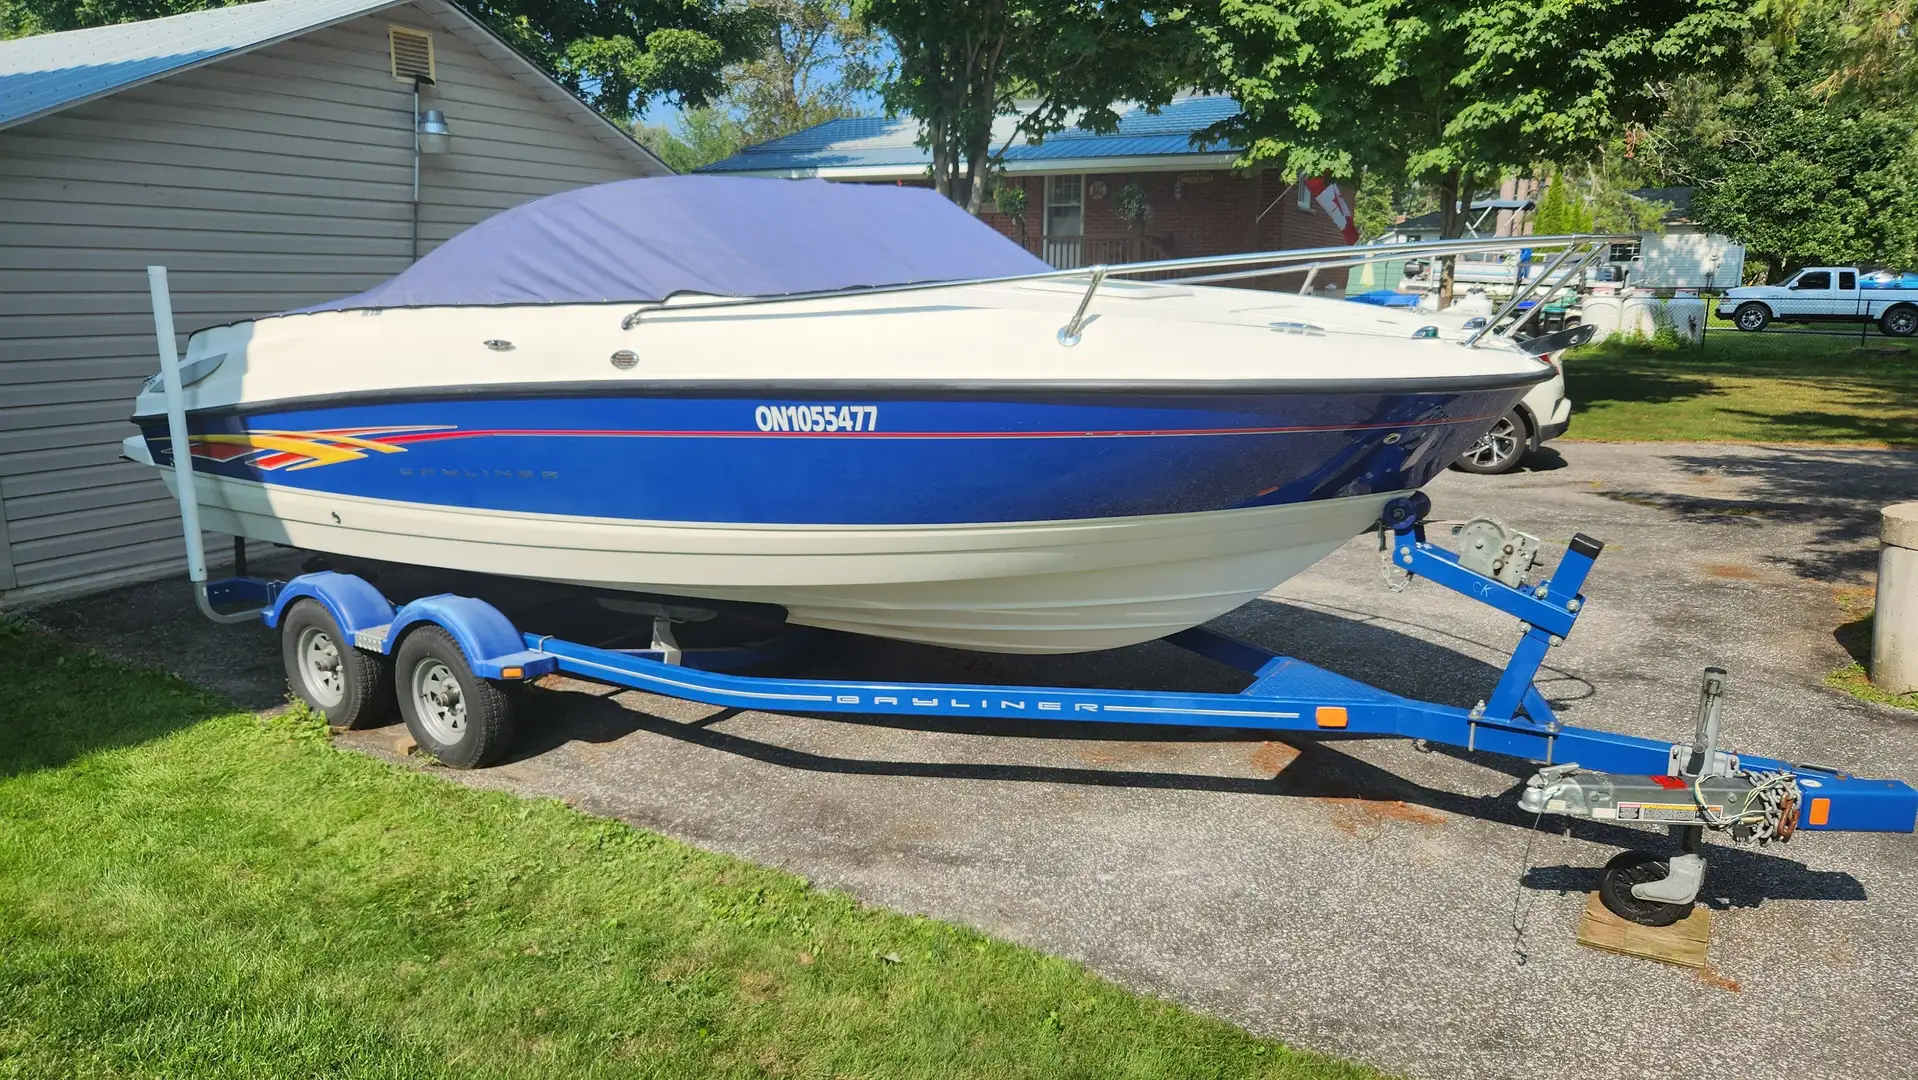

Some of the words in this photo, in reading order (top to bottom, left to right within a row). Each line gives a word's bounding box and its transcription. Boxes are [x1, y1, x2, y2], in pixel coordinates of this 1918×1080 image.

[755, 405, 878, 432] ON1055477
[1472, 581, 1492, 598] CK
[836, 694, 1099, 712] BAYLINER
